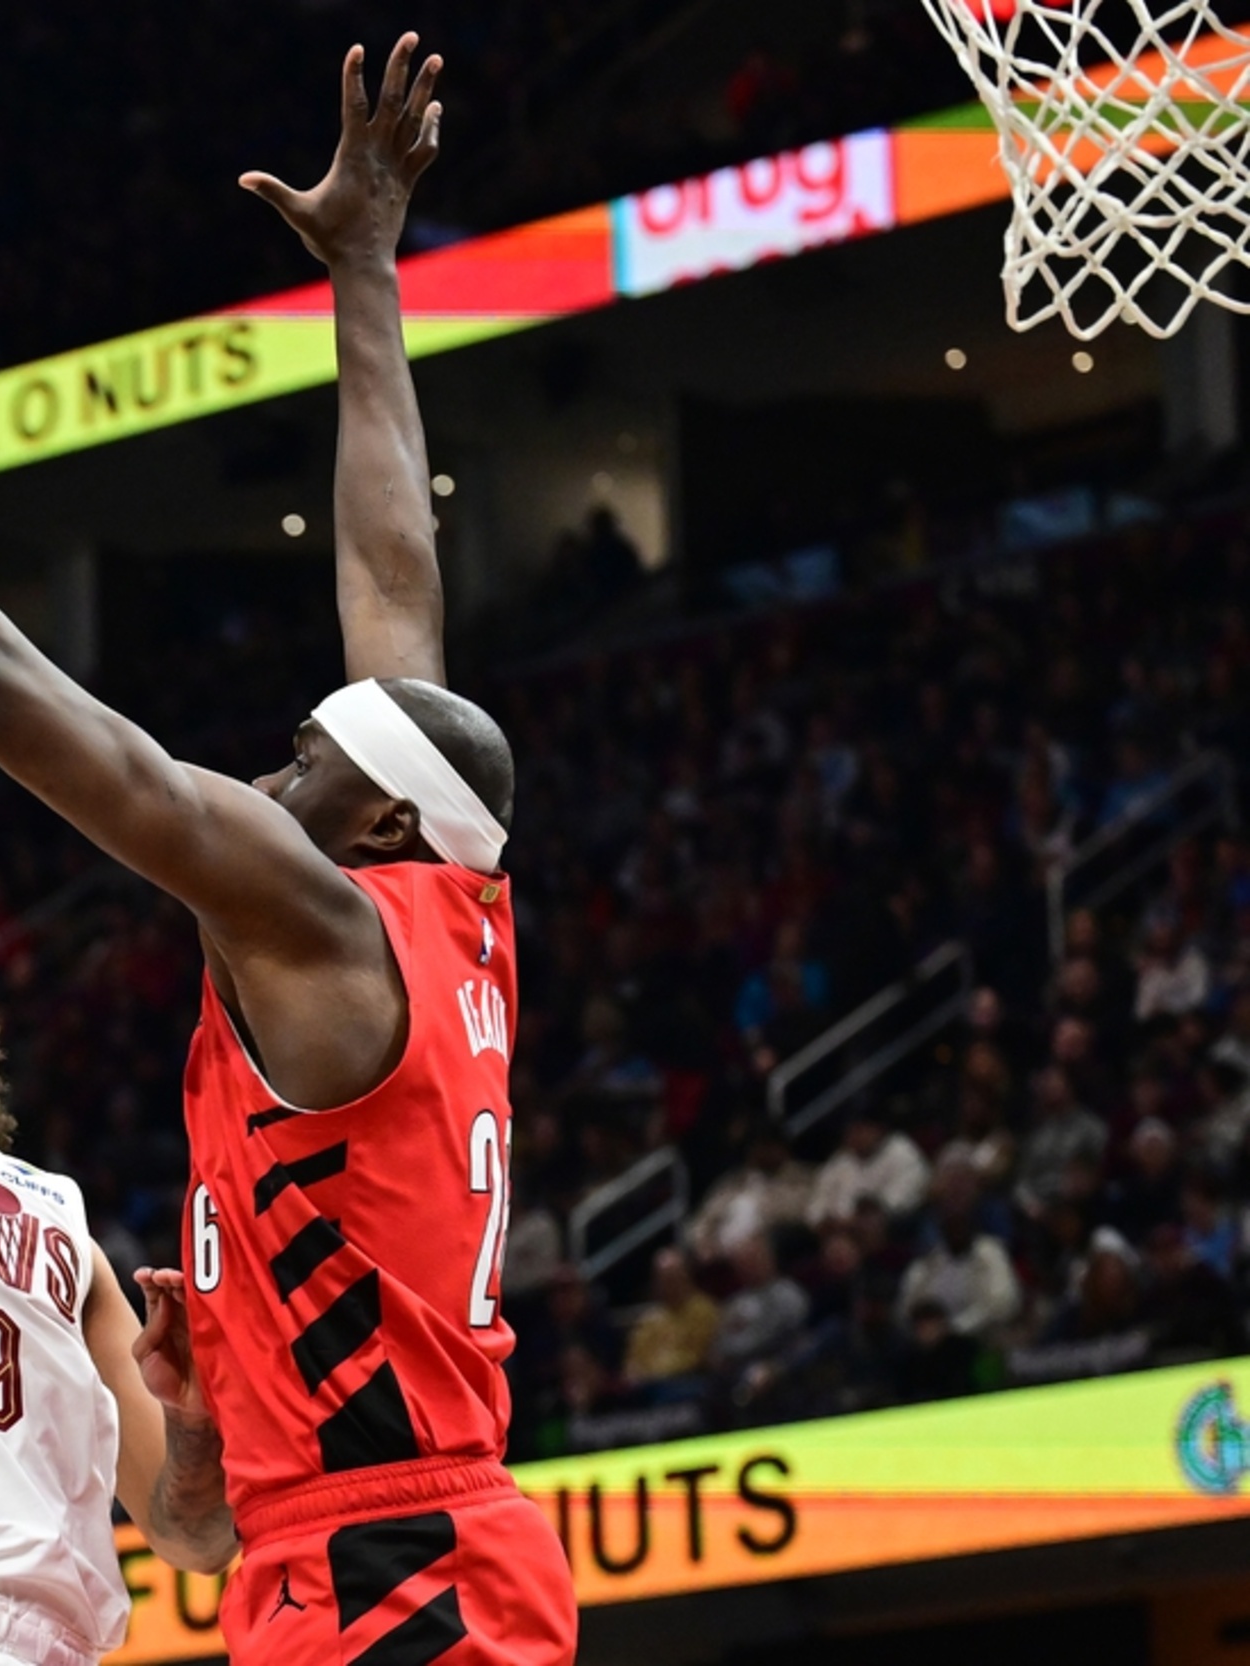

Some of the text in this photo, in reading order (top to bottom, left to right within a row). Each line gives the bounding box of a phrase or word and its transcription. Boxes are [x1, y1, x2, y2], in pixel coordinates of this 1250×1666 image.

[11, 377, 60, 442] O
[79, 320, 258, 427] NUTS
[192, 1181, 221, 1294] 6
[469, 1108, 513, 1327] 2
